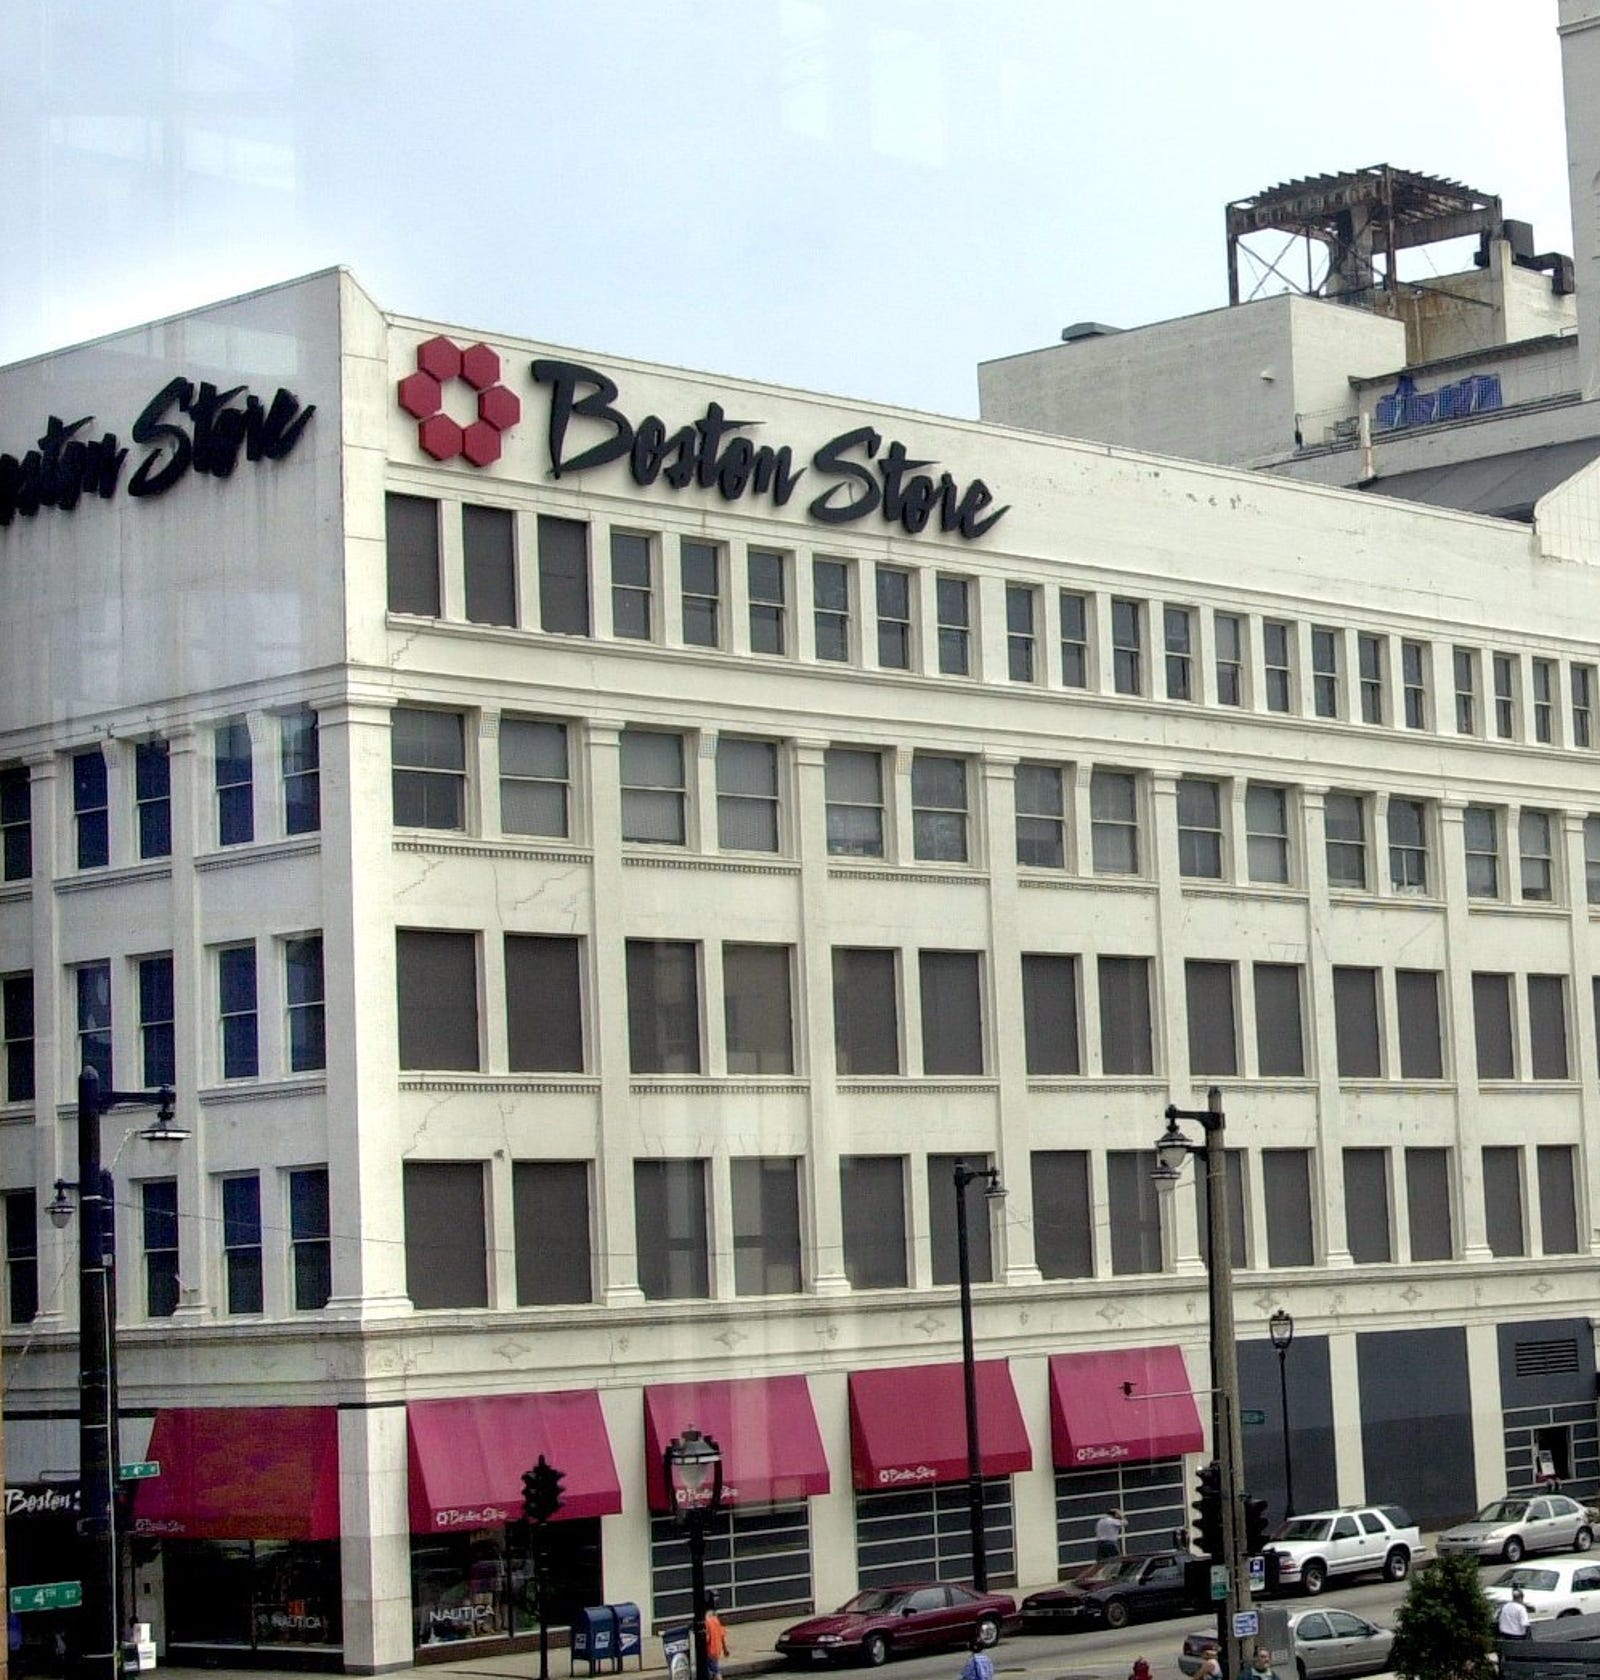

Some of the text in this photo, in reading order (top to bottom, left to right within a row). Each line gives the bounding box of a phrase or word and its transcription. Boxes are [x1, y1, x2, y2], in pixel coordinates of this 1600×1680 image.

[0, 376, 316, 526] oston Store
[530, 359, 1011, 539] Boston Store
[5, 1489, 70, 1516] Boston
[430, 1605, 496, 1622] NAUTICA
